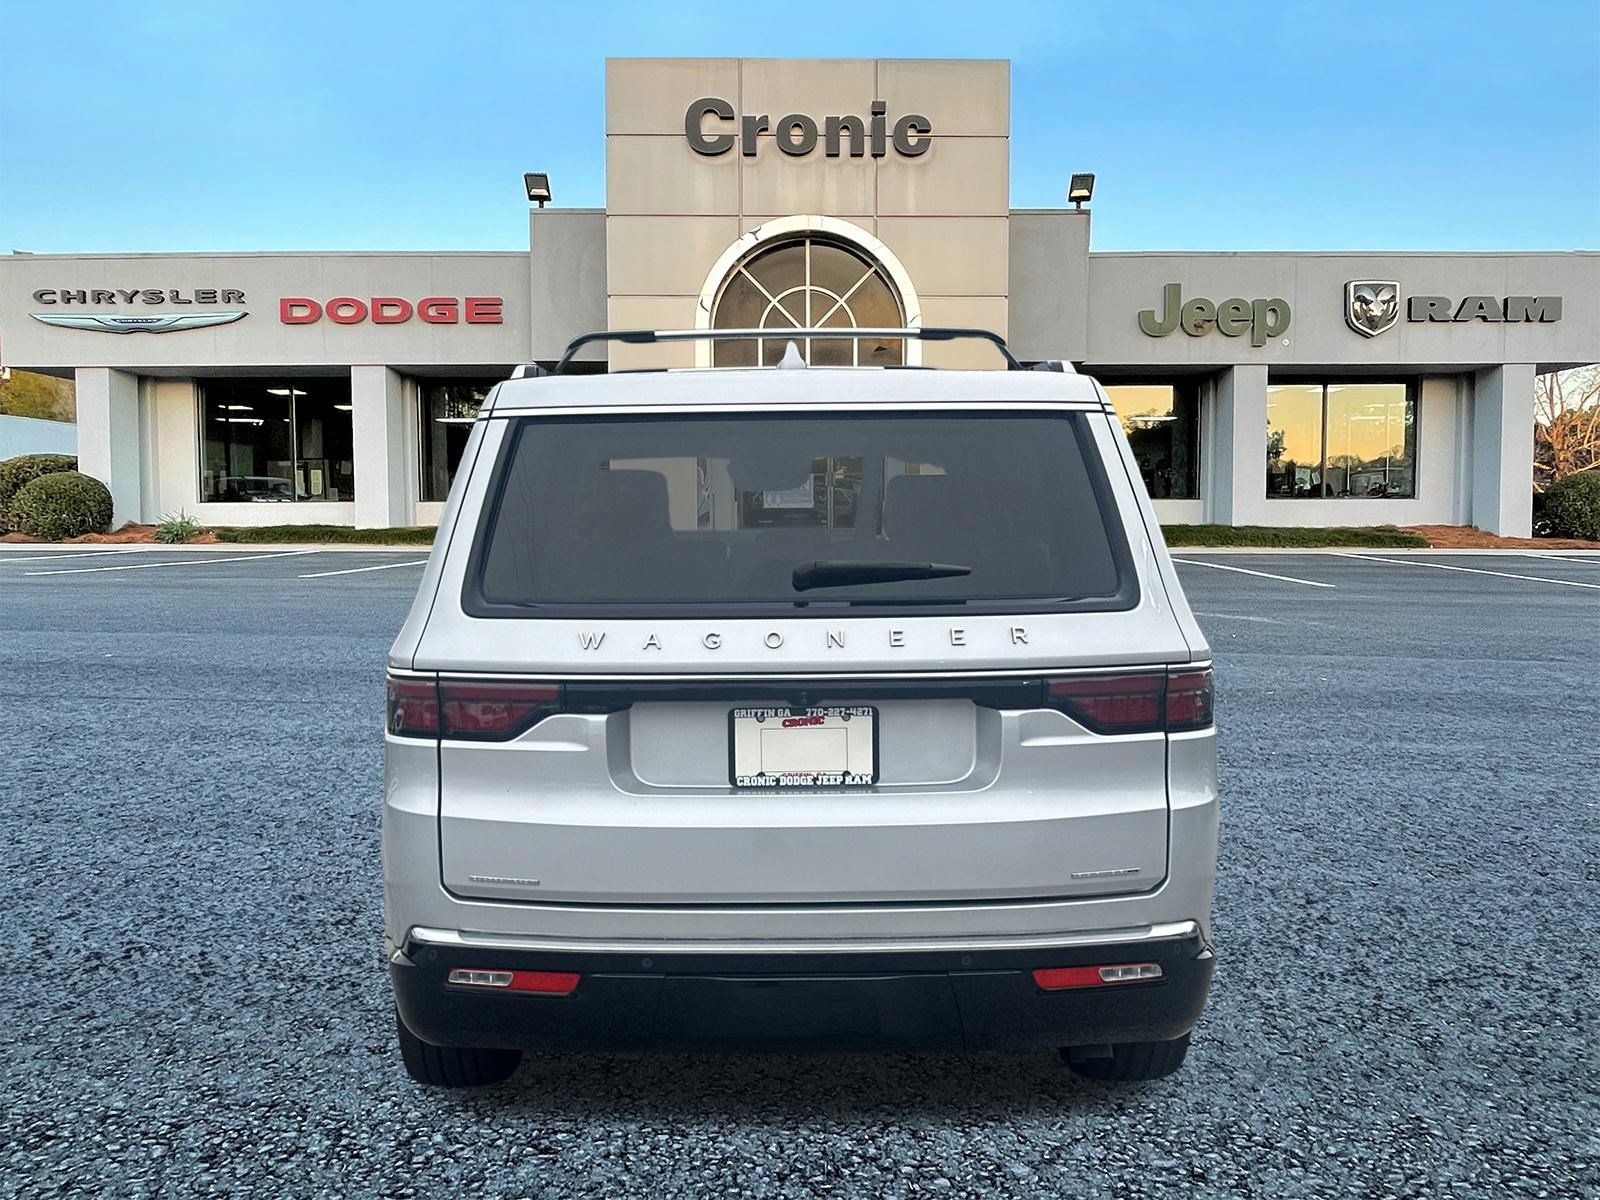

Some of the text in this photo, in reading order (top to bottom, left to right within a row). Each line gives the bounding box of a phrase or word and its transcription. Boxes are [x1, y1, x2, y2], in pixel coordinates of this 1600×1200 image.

[685, 97, 932, 157] Cronic
[33, 289, 246, 304] CHRYSLER
[279, 297, 503, 324] DODGE
[1138, 283, 1291, 347] Jeep
[1407, 296, 1563, 322] RAM
[578, 626, 1030, 650] WAGONEER
[734, 708, 873, 718] GRIFFIN GA 770-227-4271
[782, 716, 824, 727] CRONIC
[736, 774, 873, 786] CRONIC DODGE JEEP RAM
